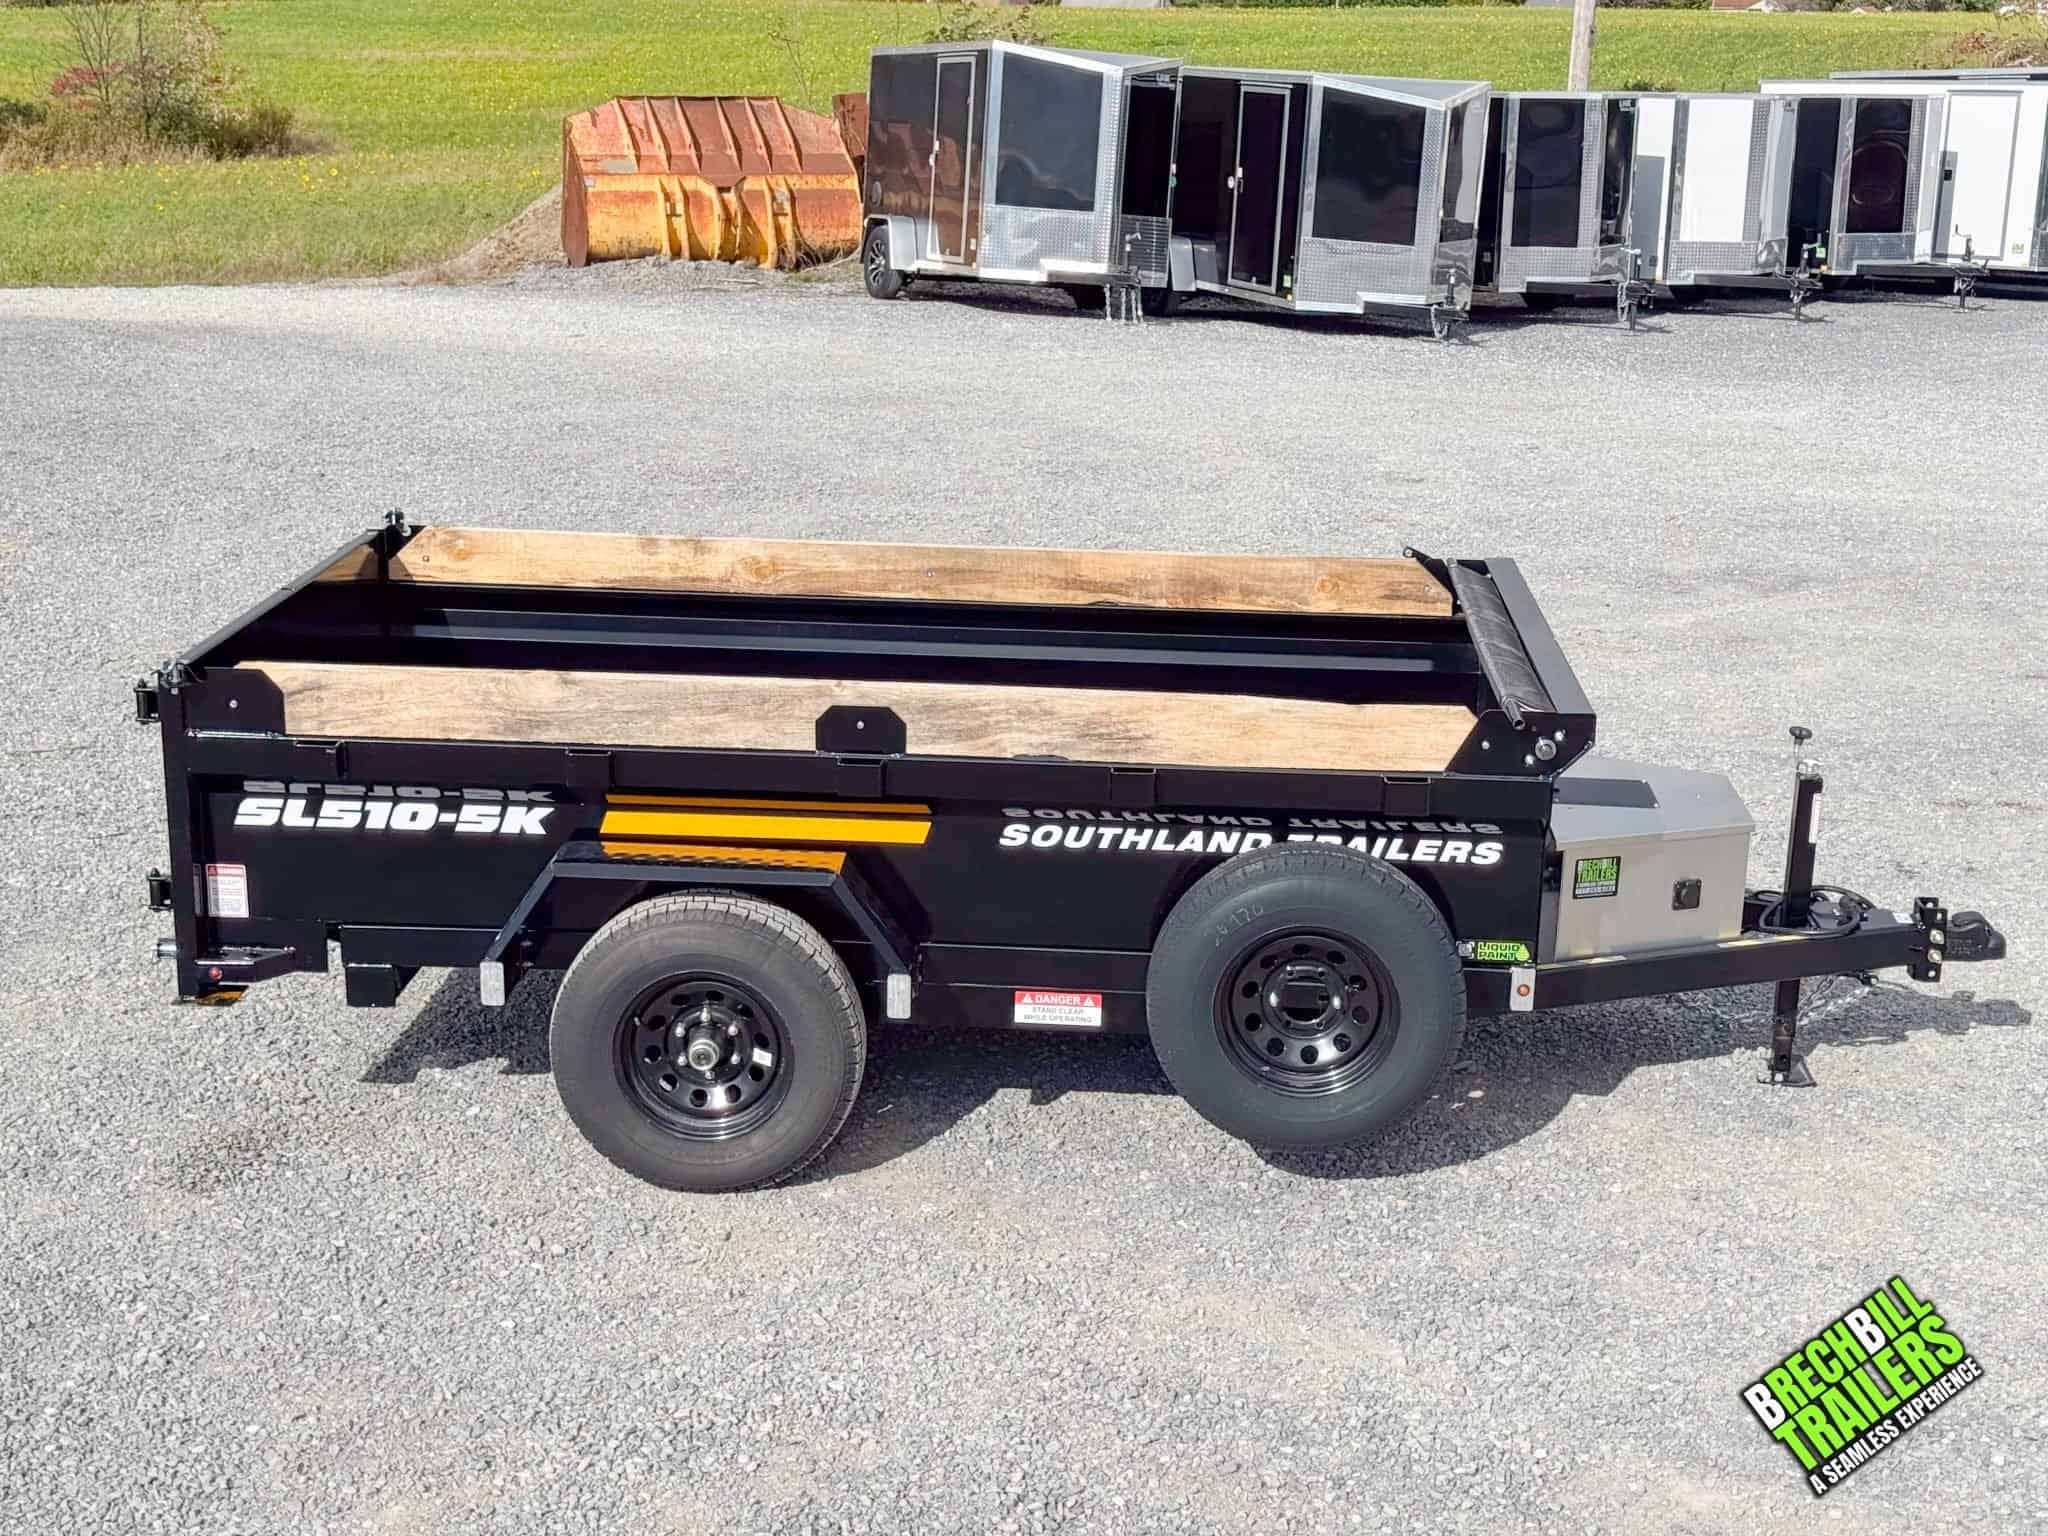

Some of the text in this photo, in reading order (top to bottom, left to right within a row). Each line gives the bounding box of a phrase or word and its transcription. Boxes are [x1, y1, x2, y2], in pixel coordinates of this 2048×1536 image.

[233, 797, 555, 834] SL510-5K
[999, 824, 1273, 853] SOUTHLAND
[1479, 943, 1520, 952] LIQUID
[1479, 951, 1515, 960] PAINT
[1034, 992, 1082, 1005] DANGER
[1032, 1006, 1084, 1015] STAND CLEAR
[1049, 1014, 1092, 1023] OPERATING
